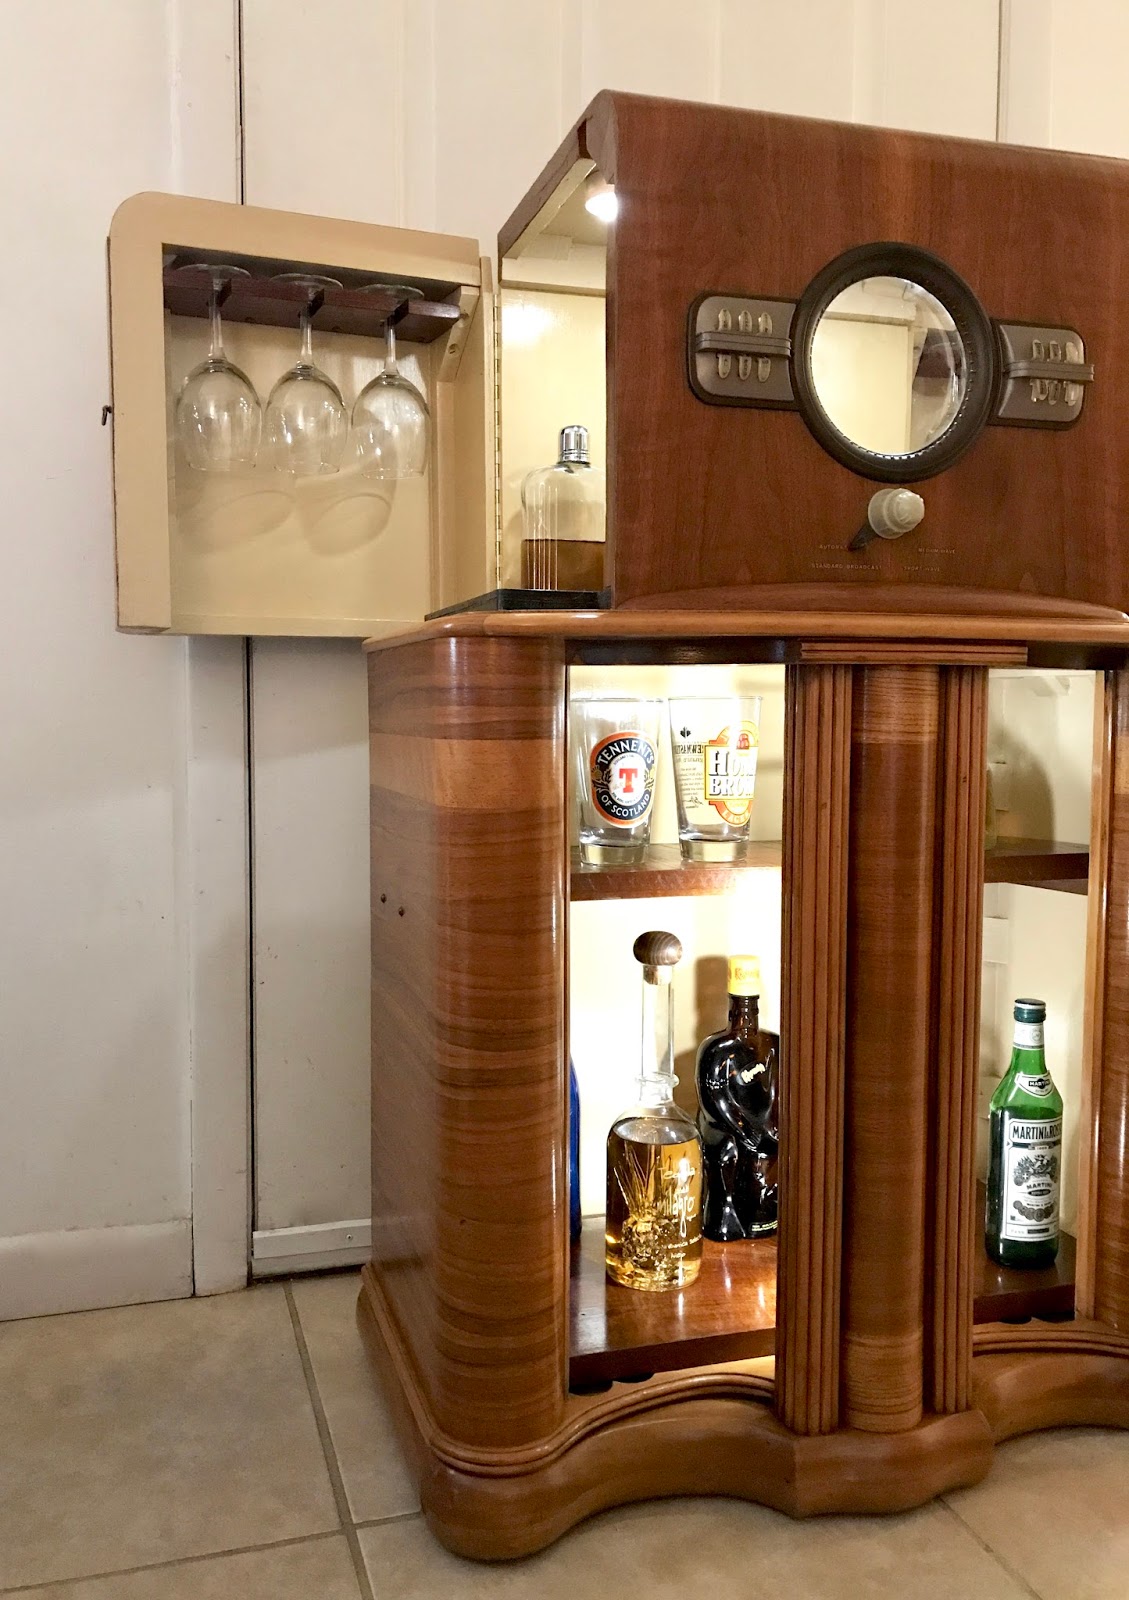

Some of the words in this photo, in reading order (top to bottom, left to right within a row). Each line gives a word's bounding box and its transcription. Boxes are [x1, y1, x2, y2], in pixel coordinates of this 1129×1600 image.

[597, 739, 654, 765] TENNENT'S
[618, 767, 638, 794] T
[601, 794, 613, 807] OF
[611, 793, 650, 817] SCOTLAND
